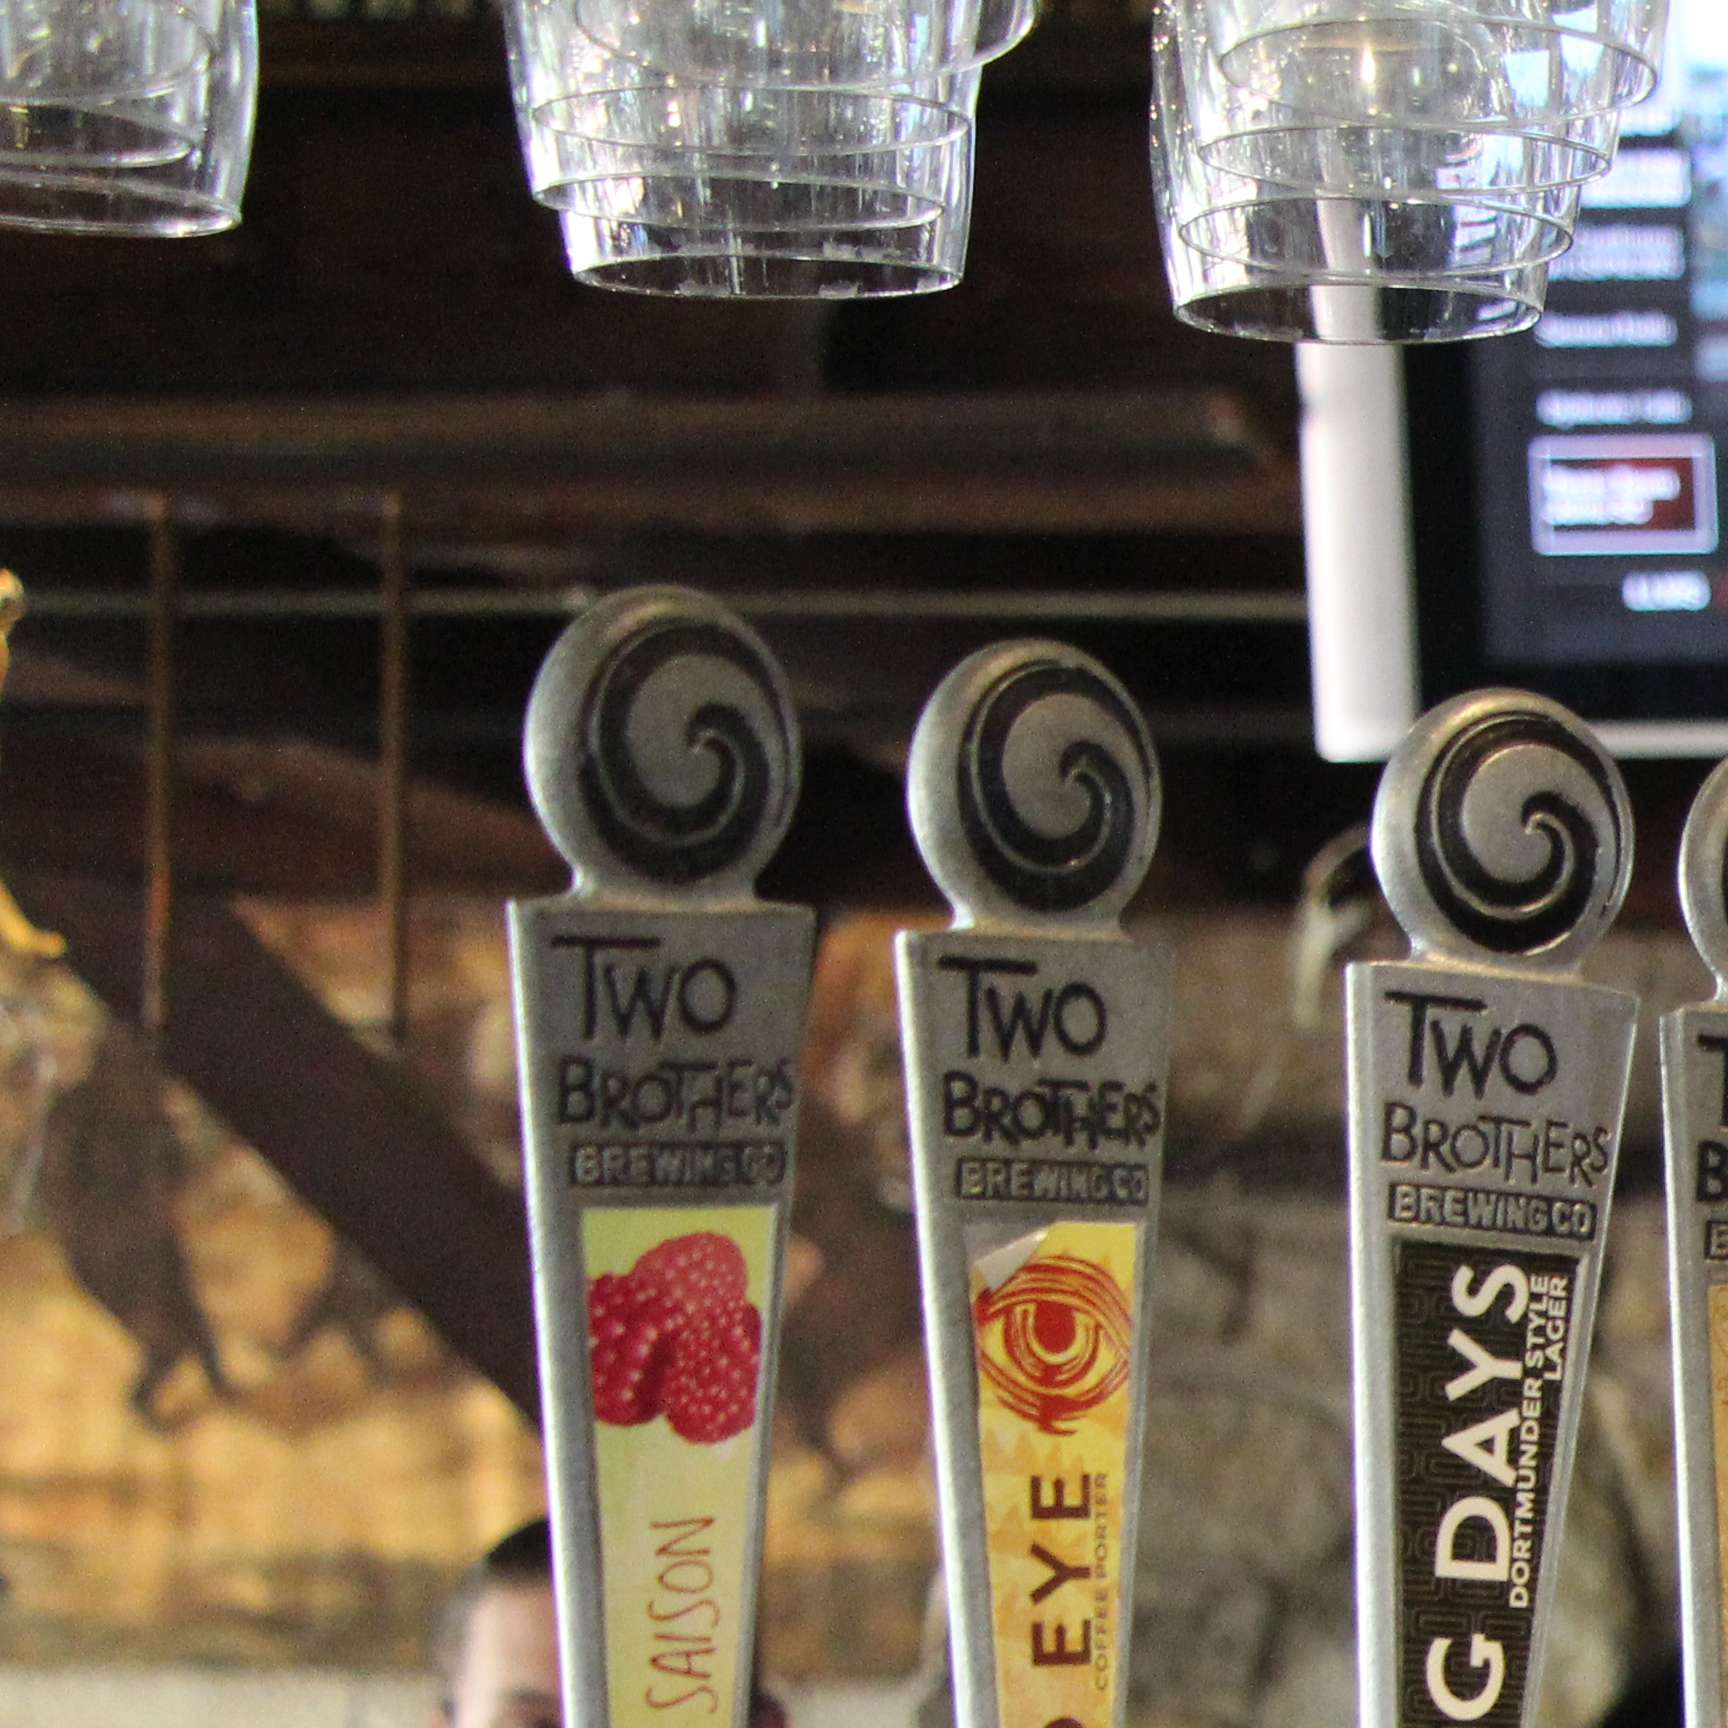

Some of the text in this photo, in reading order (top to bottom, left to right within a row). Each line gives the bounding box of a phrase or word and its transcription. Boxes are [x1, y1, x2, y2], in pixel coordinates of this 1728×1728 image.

[552, 935, 737, 1041] TWO
[939, 956, 1106, 1062] TWO
[558, 1056, 793, 1130] BROTHERS
[1385, 991, 1557, 1098] TWO
[575, 1144, 737, 1184] BREWING
[942, 1072, 1159, 1150] BROTHERS
[1380, 1102, 1609, 1187] BROTHERS
[960, 1160, 1106, 1200] BREWING
[1394, 1187, 1548, 1231] BREWING
[1542, 1275, 1569, 1381] LAGER
[1436, 1264, 1529, 1582] DAYS
[1510, 1275, 1552, 1608] DORTMUNDER STYLE
[646, 1515, 721, 1714] SAISON
[1029, 1473, 1092, 1667] EYE
[1094, 1473, 1109, 1691] COFFEE PORTER
